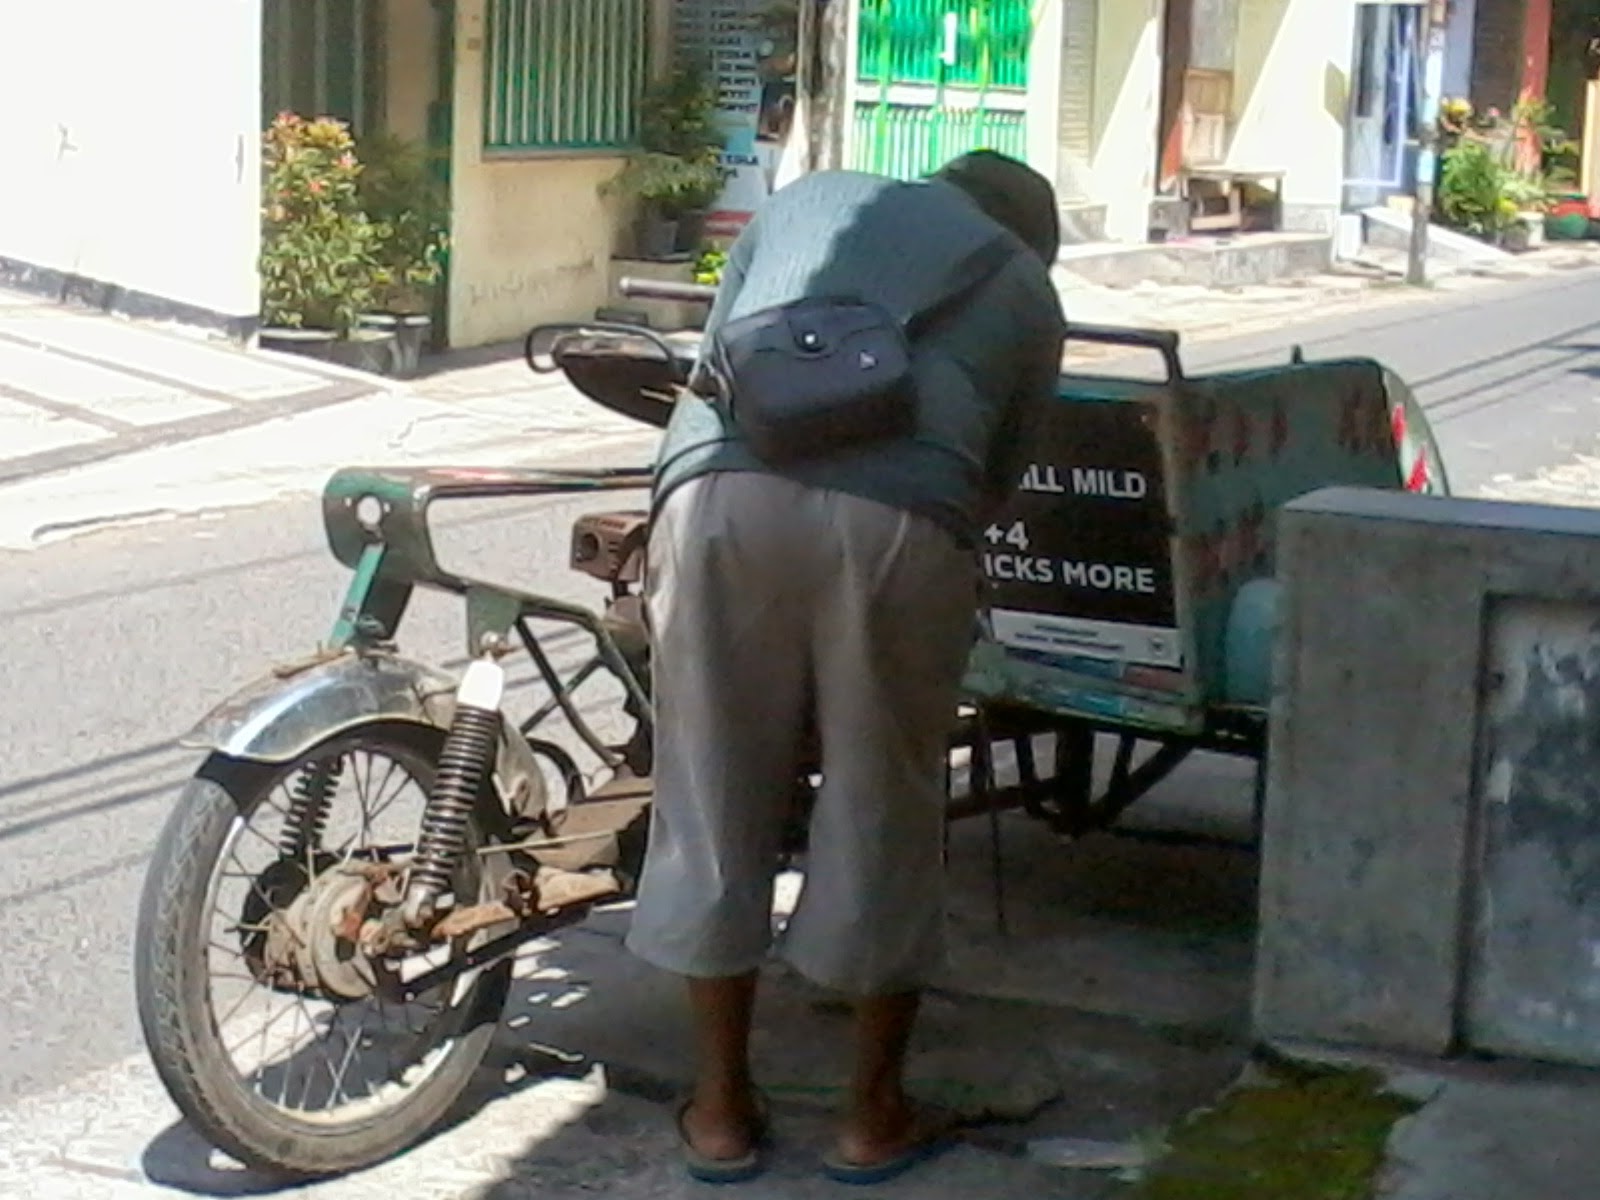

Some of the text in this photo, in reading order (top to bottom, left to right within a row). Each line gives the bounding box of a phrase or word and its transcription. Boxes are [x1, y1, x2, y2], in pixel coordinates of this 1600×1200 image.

[1018, 464, 1147, 498] ILL MILD
[984, 521, 1029, 550] +4
[1064, 561, 1155, 593] MORE
